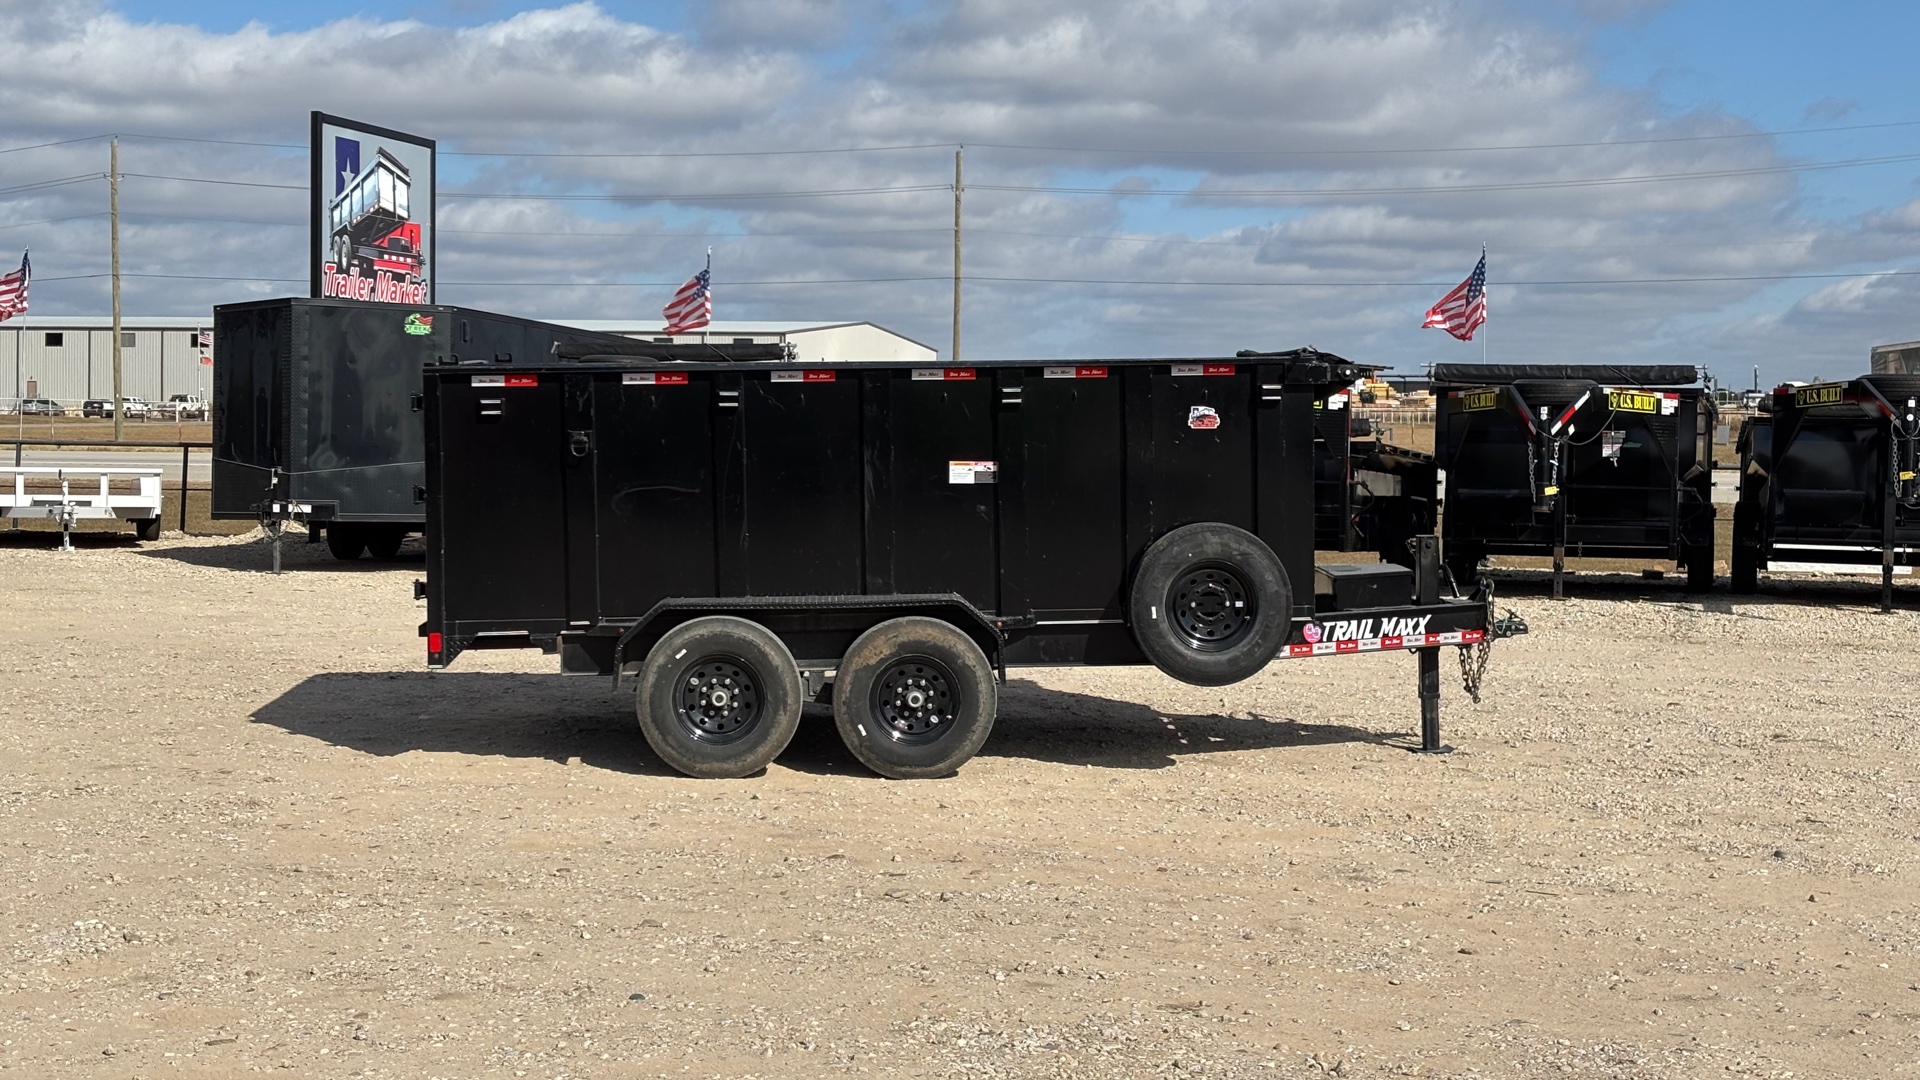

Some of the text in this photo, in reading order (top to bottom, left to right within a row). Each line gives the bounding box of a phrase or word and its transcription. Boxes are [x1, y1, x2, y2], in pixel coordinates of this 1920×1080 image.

[324, 263, 427, 304] Trailer Market
[1620, 394, 1633, 408] U.S.
[1633, 395, 1654, 410] BUILT
[1806, 387, 1841, 403] U.S. BUILT
[1322, 618, 1375, 641] TRAIL
[1379, 614, 1432, 637] MAXX
